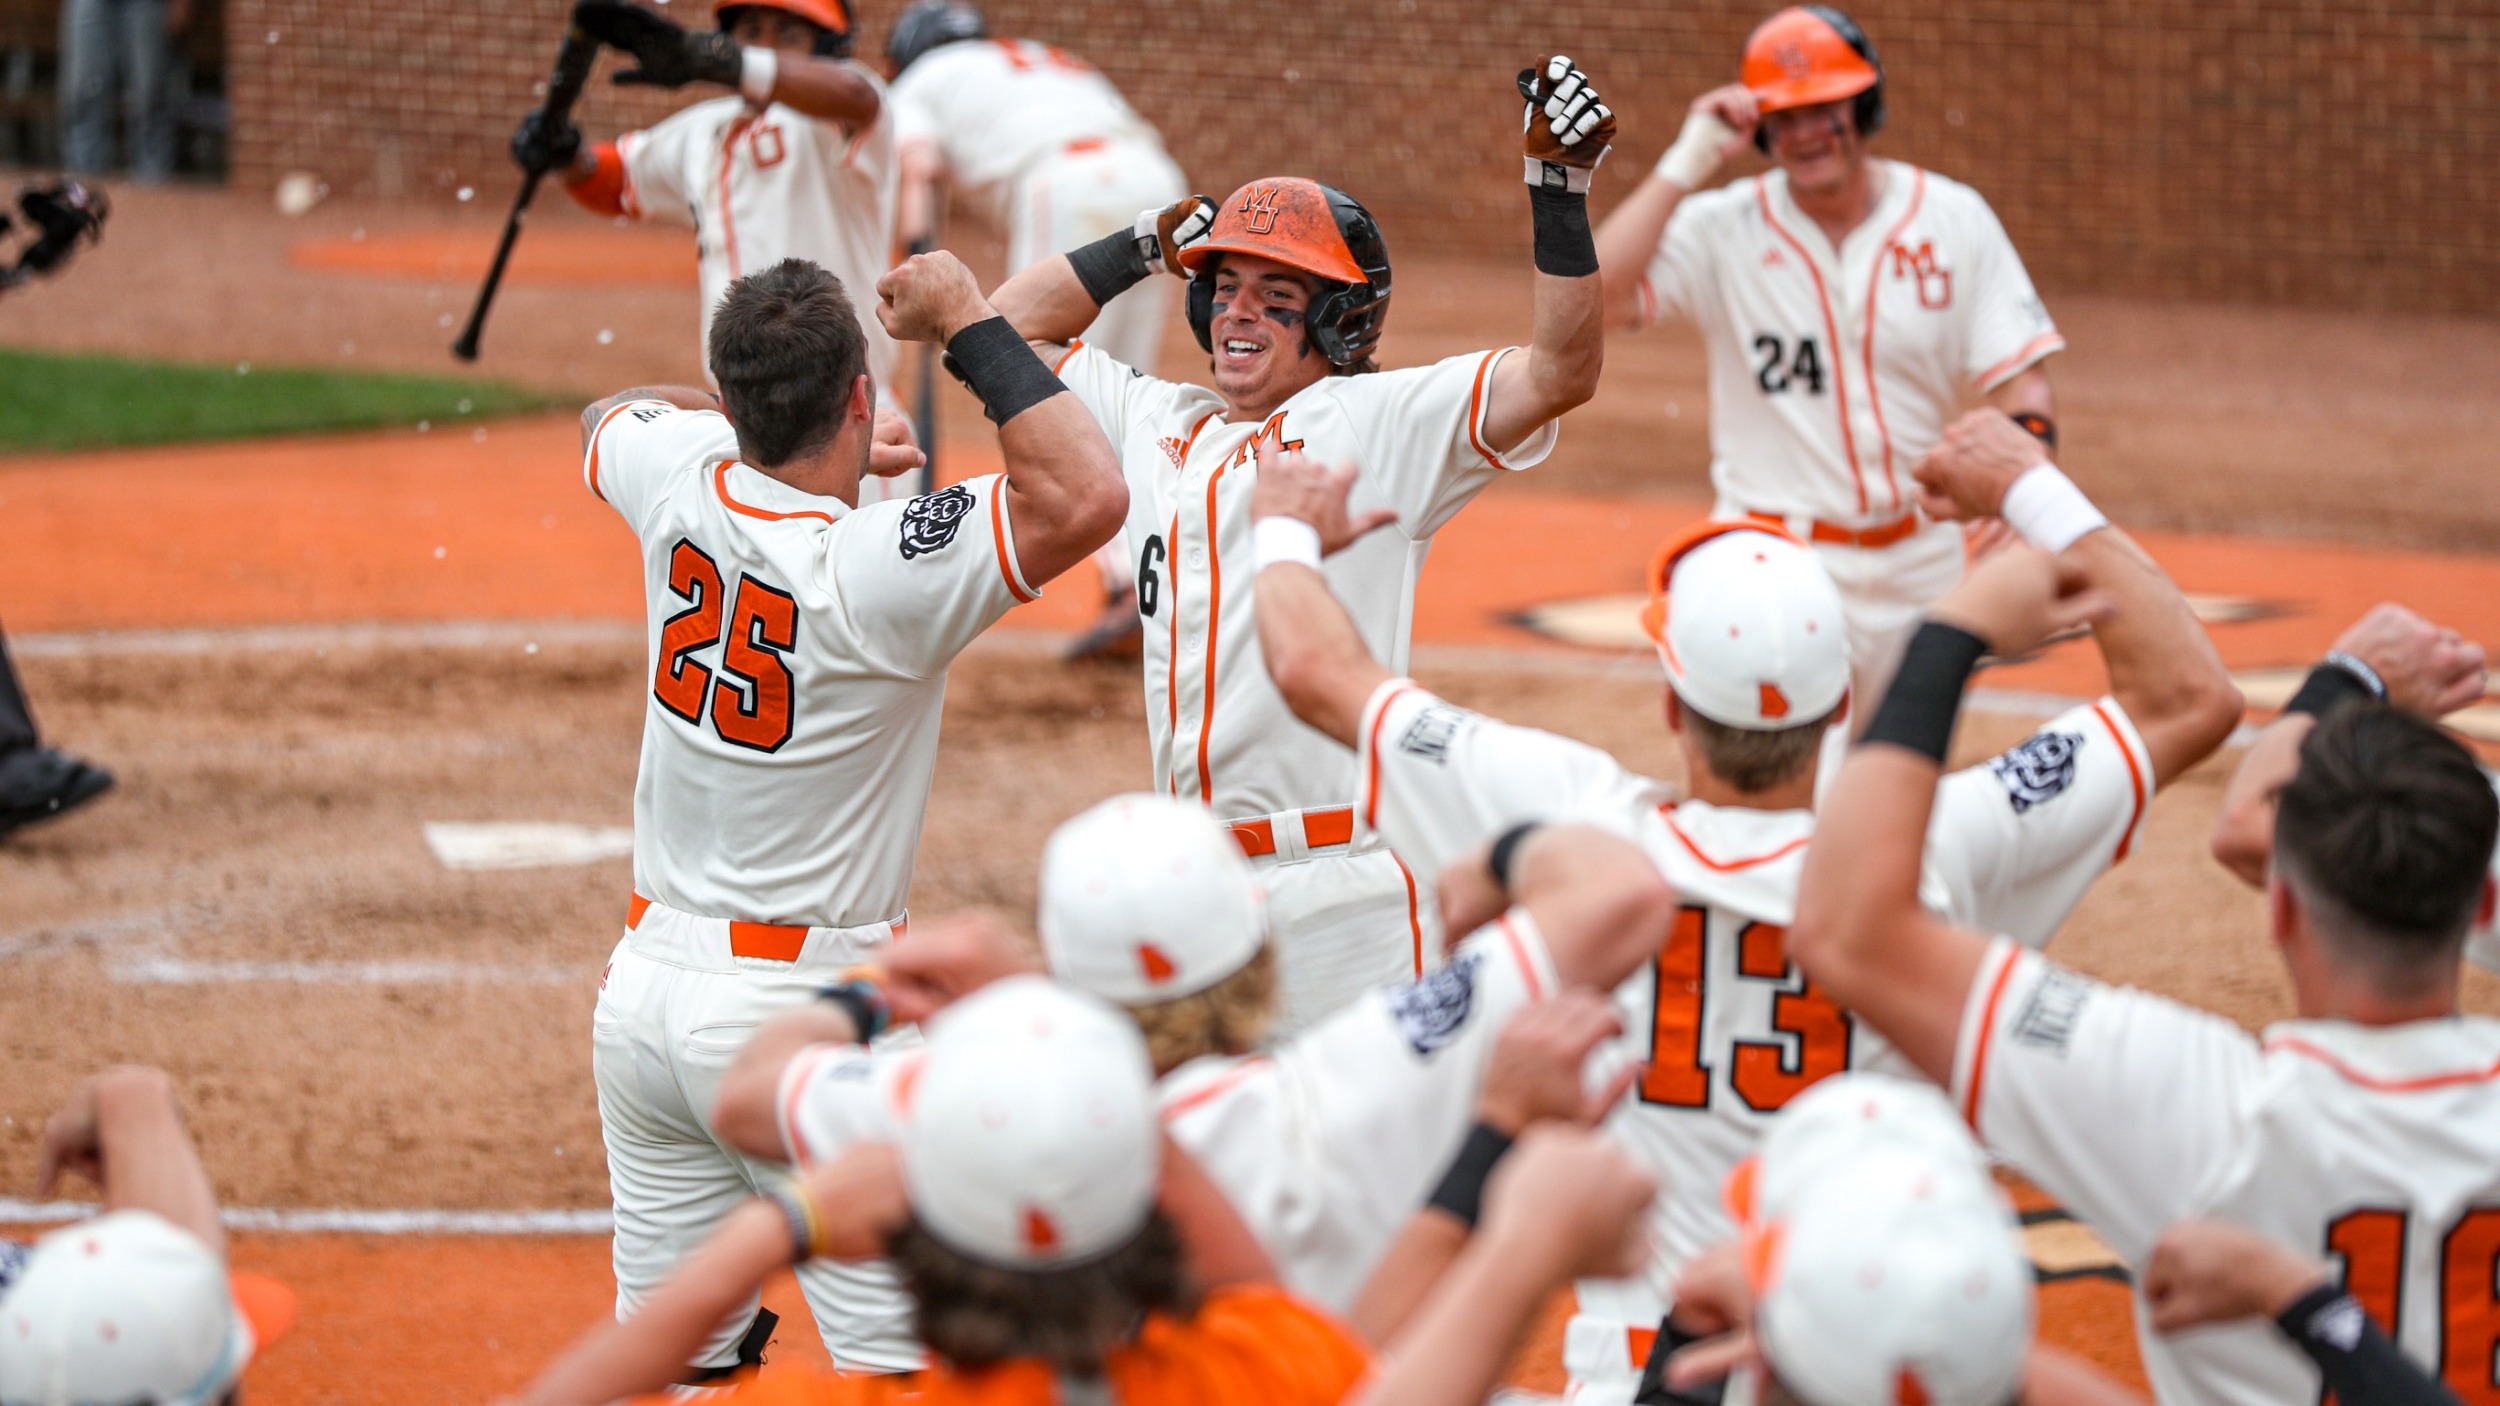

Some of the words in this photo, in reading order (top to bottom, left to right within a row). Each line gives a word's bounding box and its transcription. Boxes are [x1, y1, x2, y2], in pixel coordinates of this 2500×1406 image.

[1239, 186, 1279, 235] MU
[1885, 237, 1953, 310] MU
[1754, 333, 1826, 396] 24
[1234, 411, 1304, 470] M
[1138, 533, 1166, 619] 6
[653, 537, 799, 753] 25
[1638, 902, 1852, 1113] 13
